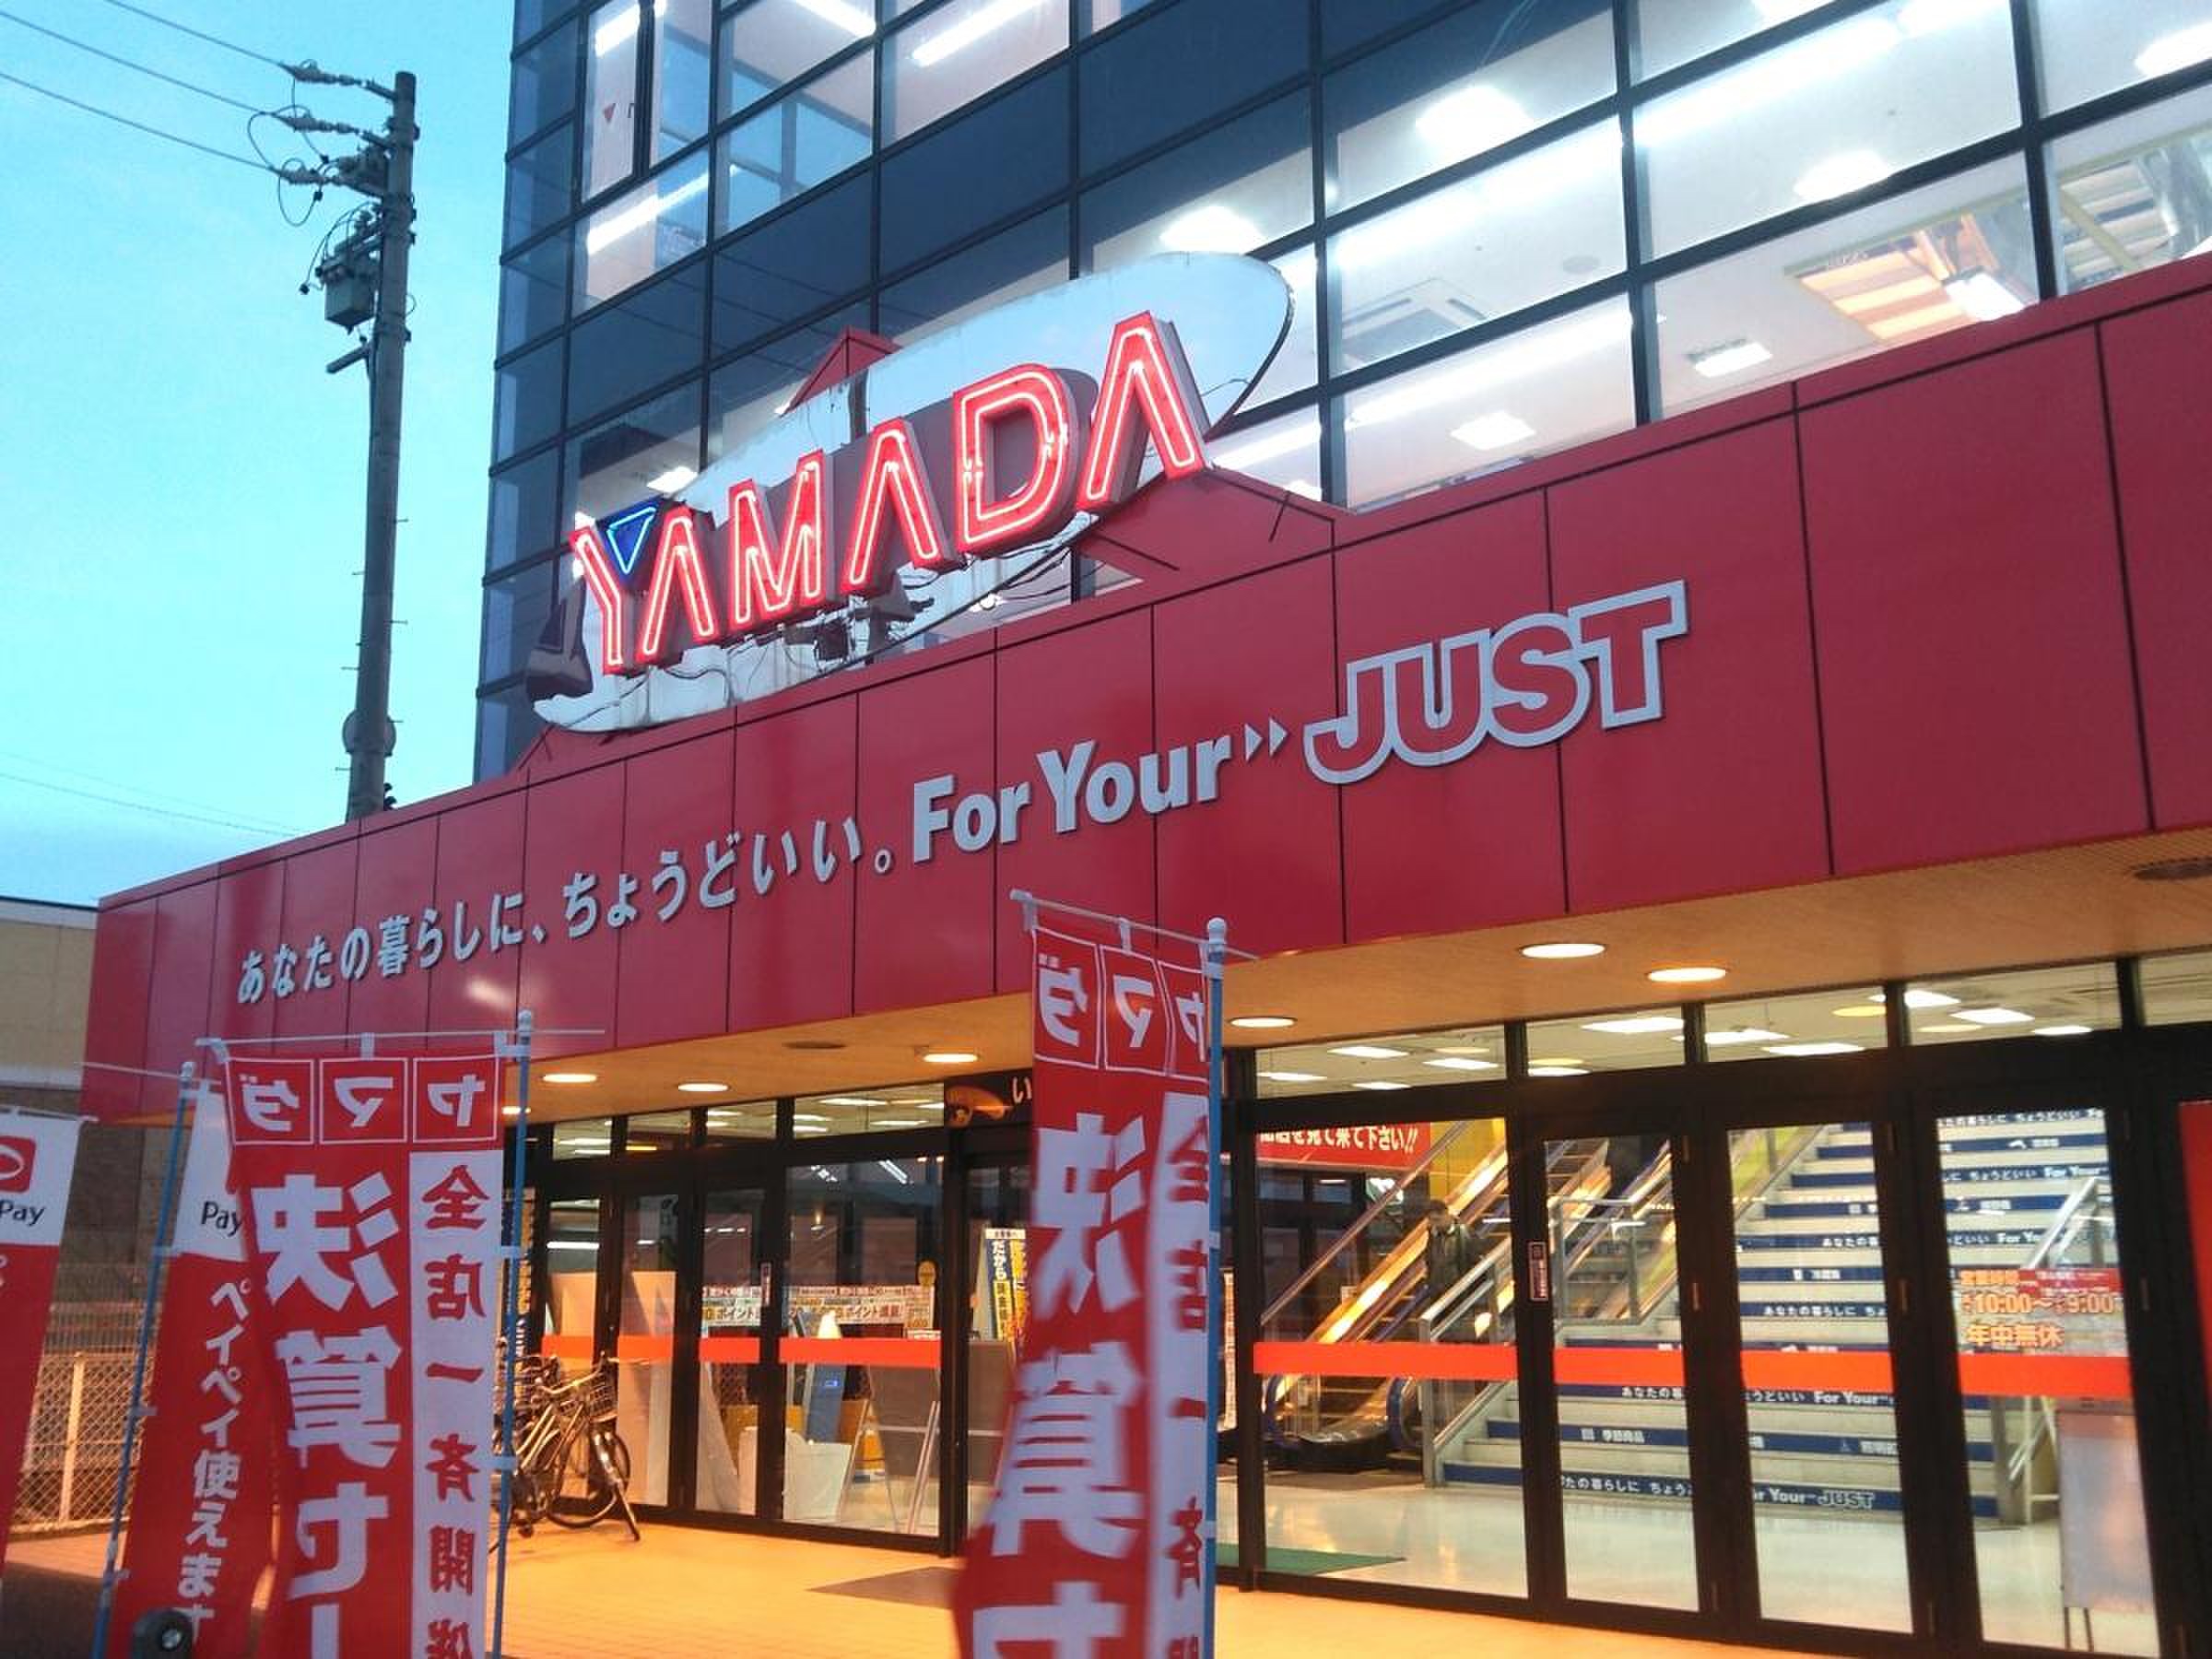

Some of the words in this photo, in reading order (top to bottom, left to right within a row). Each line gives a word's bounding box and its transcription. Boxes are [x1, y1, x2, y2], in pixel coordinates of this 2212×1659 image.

[569, 310, 1208, 675] YAMADA
[913, 774, 1029, 863] For
[1036, 735, 1233, 833] Your
[1303, 579, 1688, 784] JUST
[201, 1200, 242, 1237] Pay
